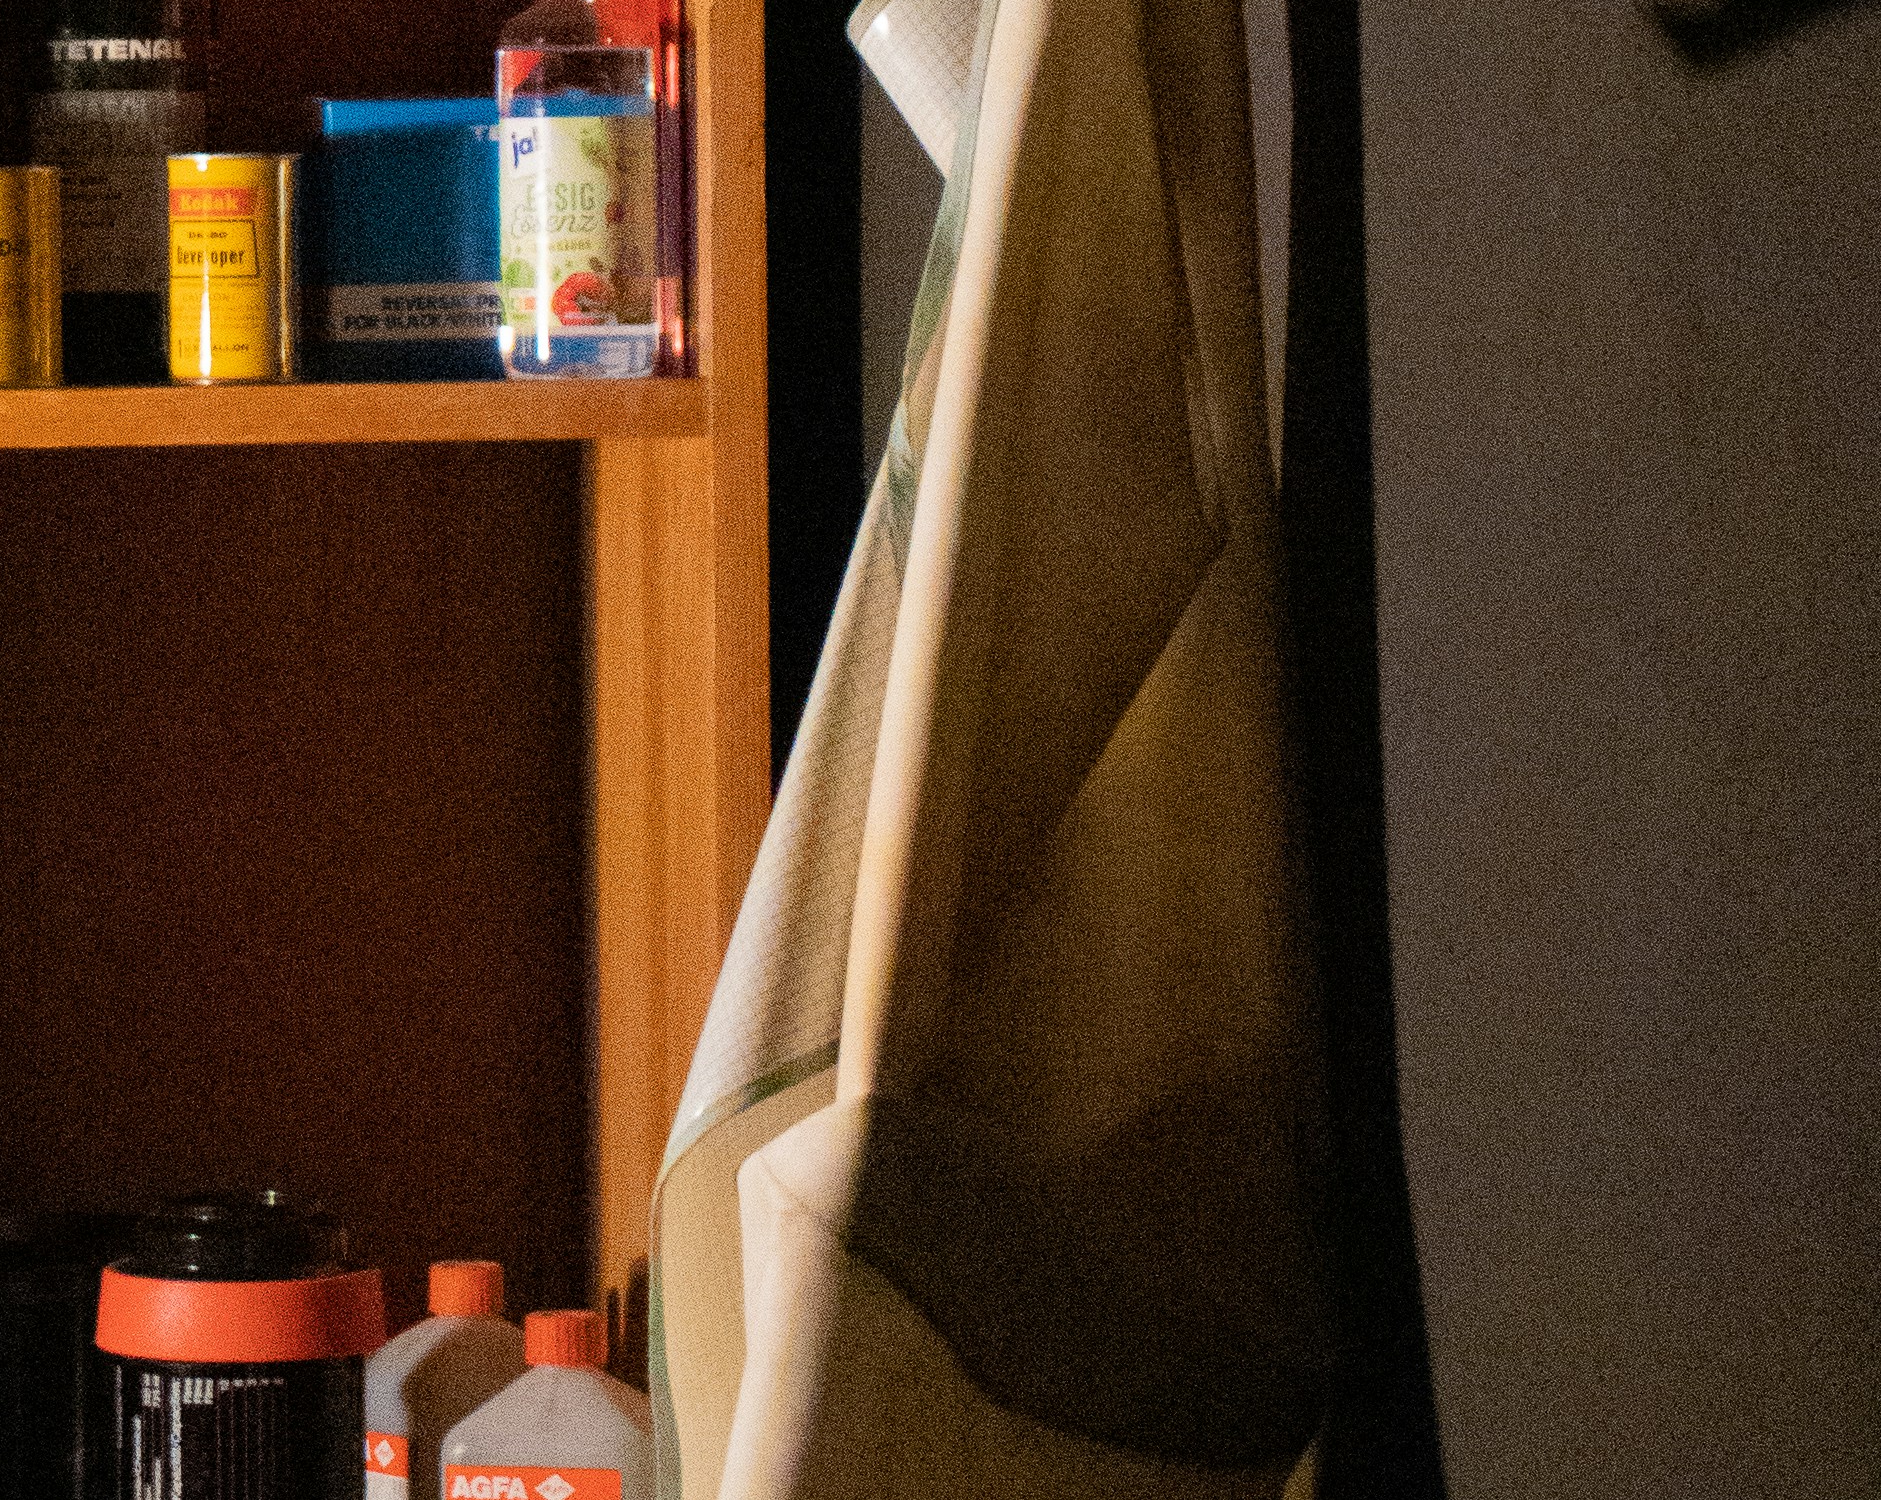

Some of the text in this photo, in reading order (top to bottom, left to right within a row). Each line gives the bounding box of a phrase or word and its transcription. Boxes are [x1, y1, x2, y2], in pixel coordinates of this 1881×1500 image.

[51, 39, 187, 61] TETENAL
[178, 193, 239, 212] Kodak
[526, 182, 595, 212] ESIG
[176, 246, 245, 268] Deveoper
